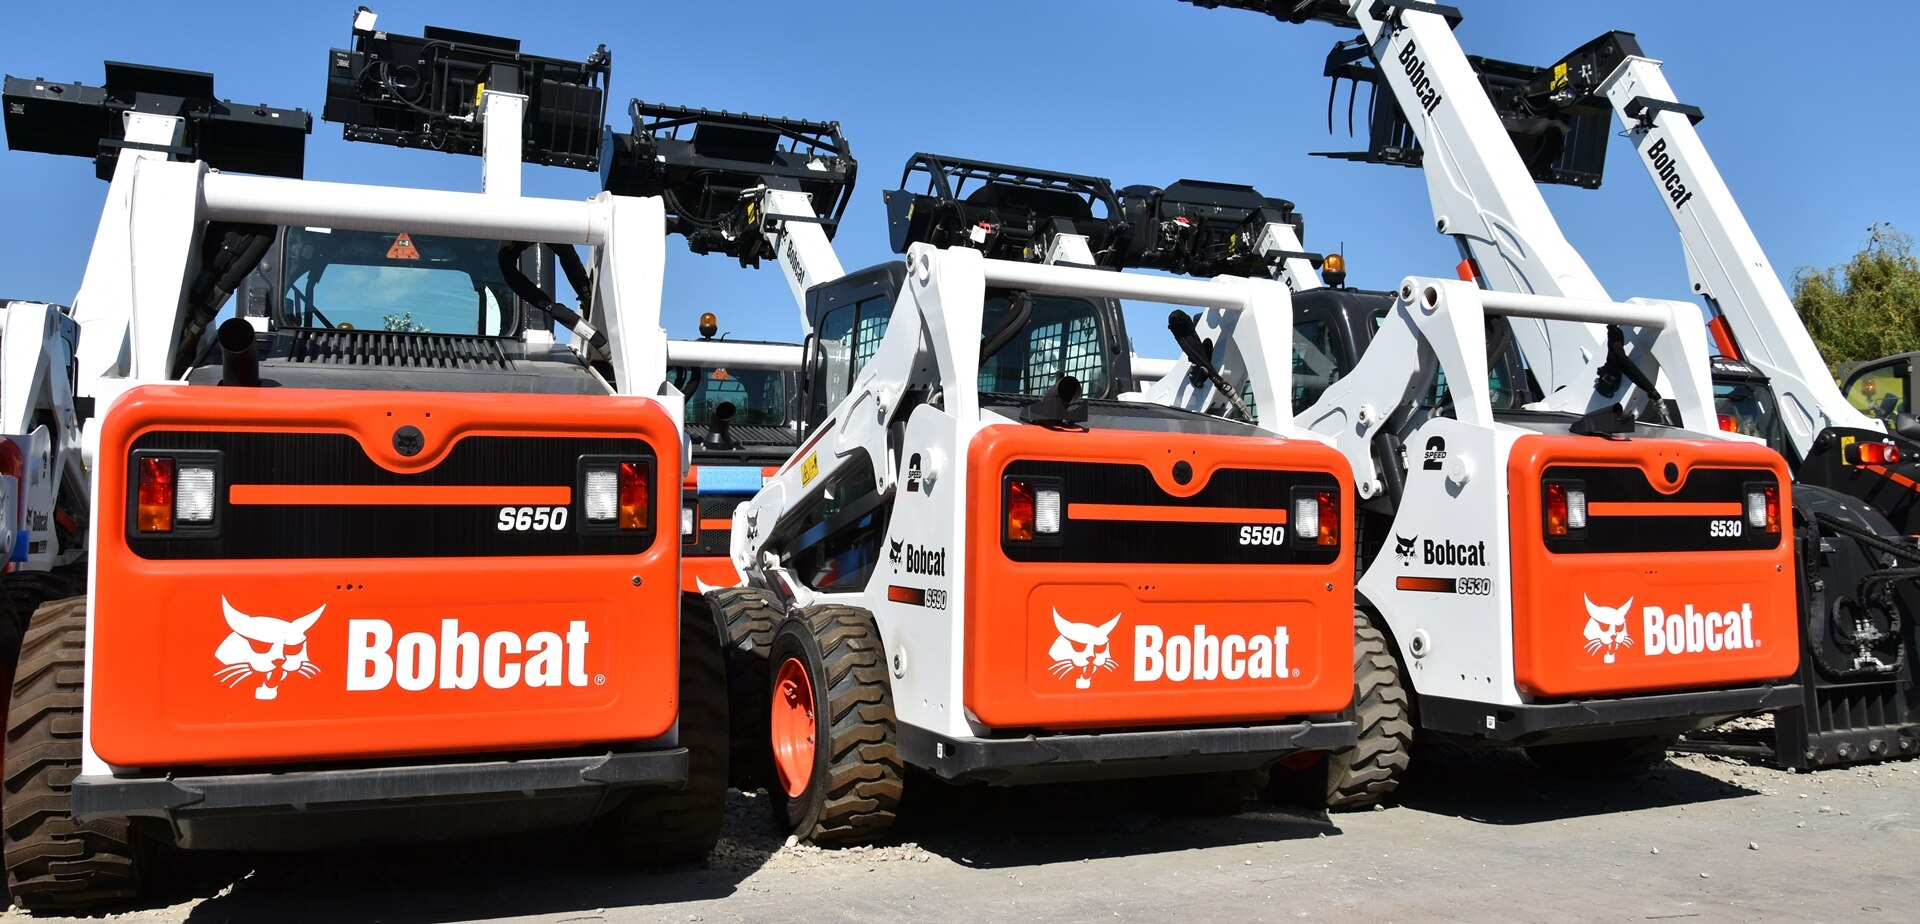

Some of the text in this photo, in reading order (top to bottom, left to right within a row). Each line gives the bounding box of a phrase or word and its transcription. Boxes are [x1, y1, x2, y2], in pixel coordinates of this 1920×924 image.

[1398, 38, 1442, 117] Bobcat
[1647, 137, 1692, 210] Bobcat
[787, 239, 805, 285] Bobcat
[1424, 451, 1447, 459] SPEED
[908, 470, 922, 479] SPEED
[497, 506, 568, 531] S650
[1710, 520, 1742, 537] S530
[1239, 526, 1285, 546] S590
[906, 543, 946, 577] Bobcat
[1423, 539, 1486, 567] Bobcat
[925, 587, 947, 611] S590
[1458, 577, 1491, 596] S530
[1643, 603, 1754, 656] Bobcat
[346, 618, 590, 692] Bobcat
[1133, 624, 1290, 682] Bobcat
